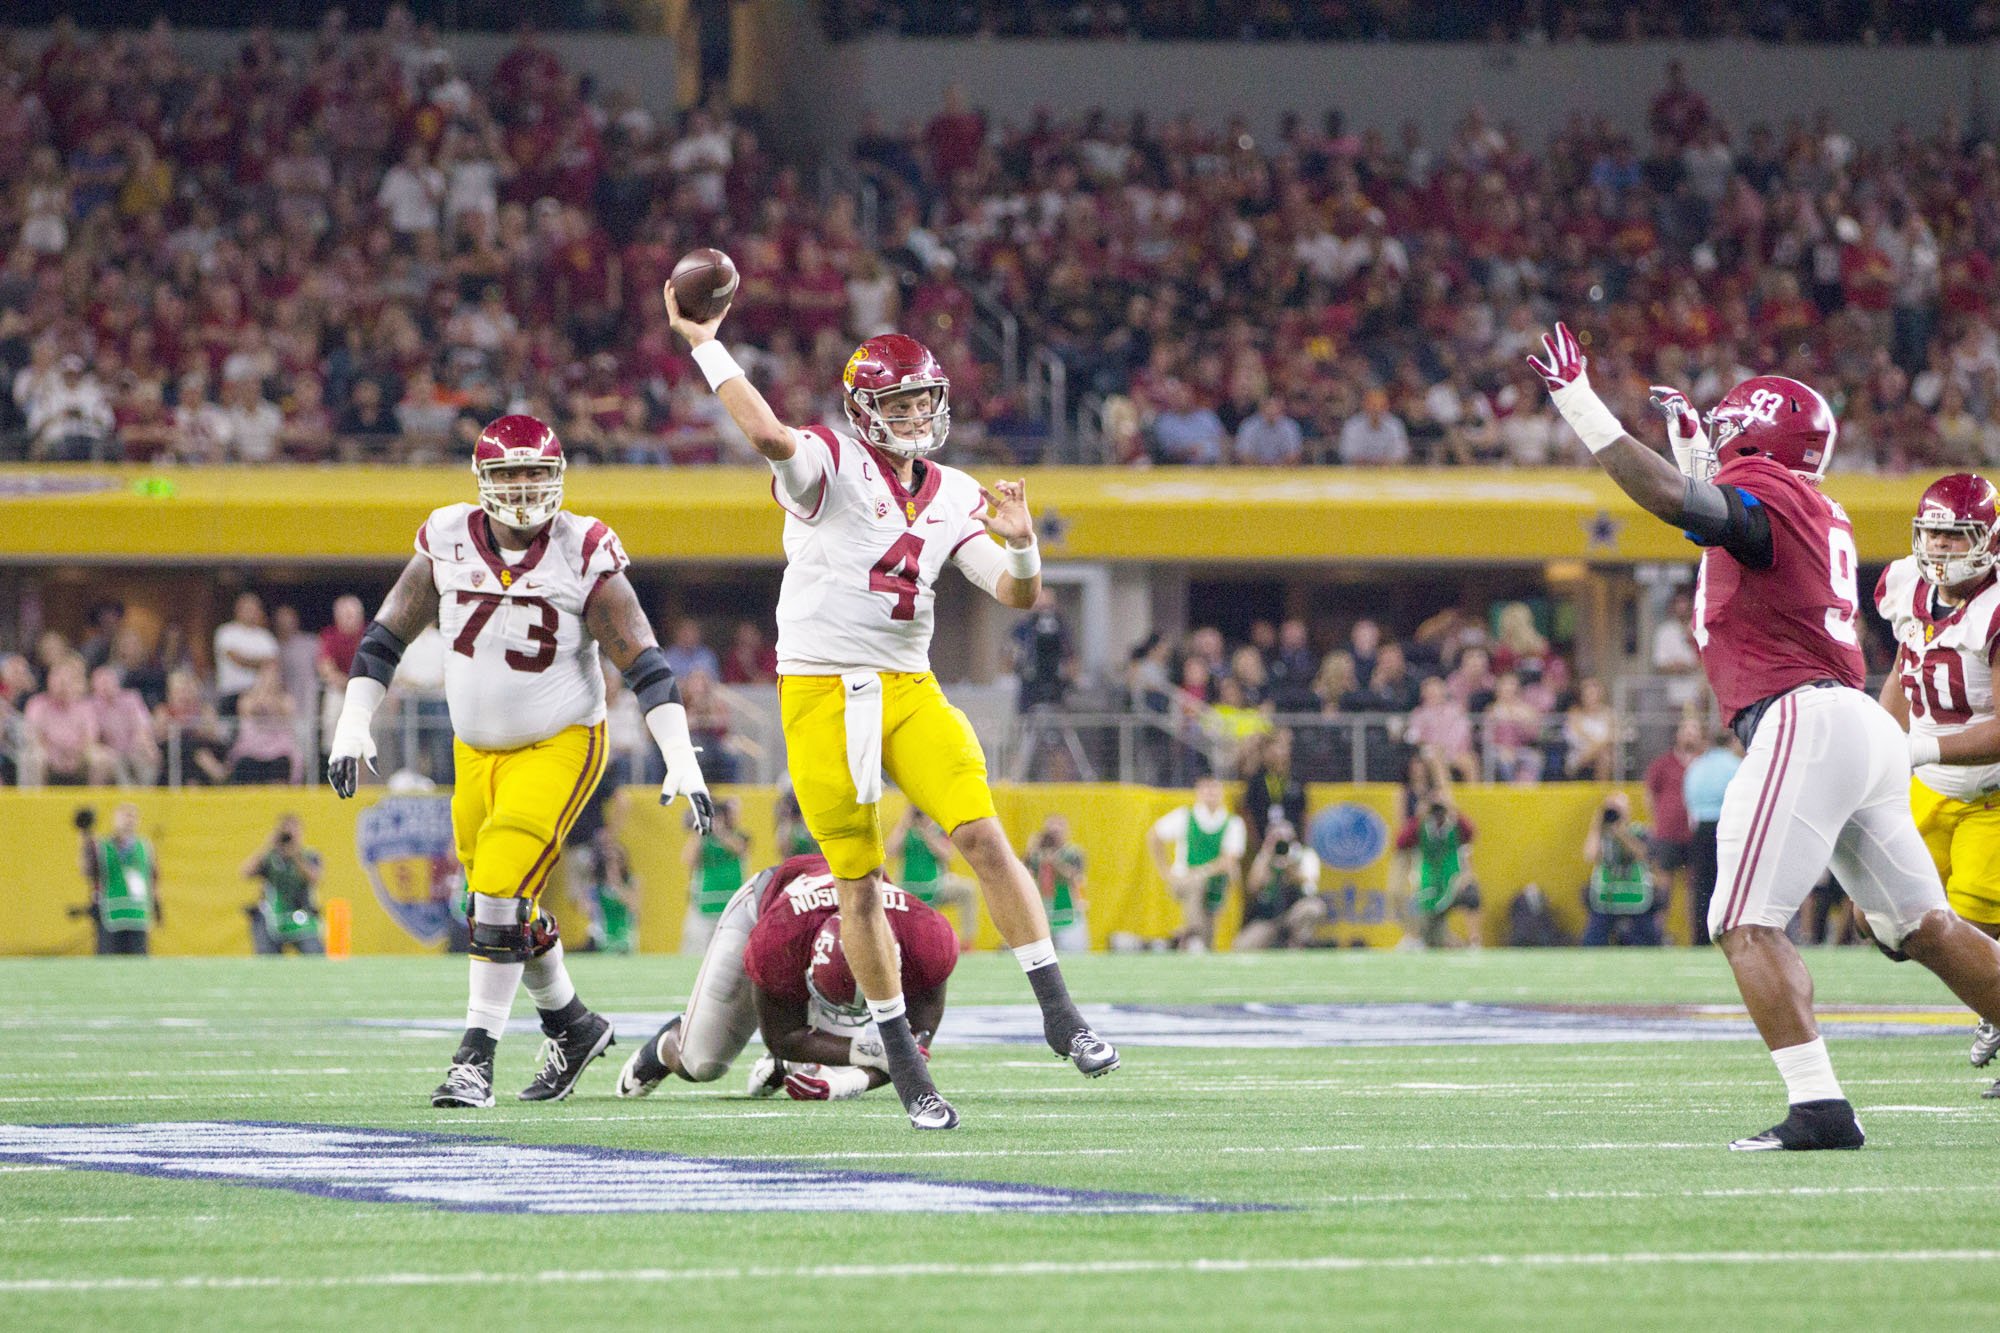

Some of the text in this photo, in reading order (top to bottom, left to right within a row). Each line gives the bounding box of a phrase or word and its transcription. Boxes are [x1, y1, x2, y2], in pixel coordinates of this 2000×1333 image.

[908, 373, 927, 383] USC
[1743, 388, 1784, 423] 93
[862, 462, 873, 481] C
[1930, 511, 1947, 519] USC
[455, 543, 464, 561] C
[869, 532, 925, 621] 4
[453, 590, 559, 673] 73
[1899, 642, 1974, 725] 60
